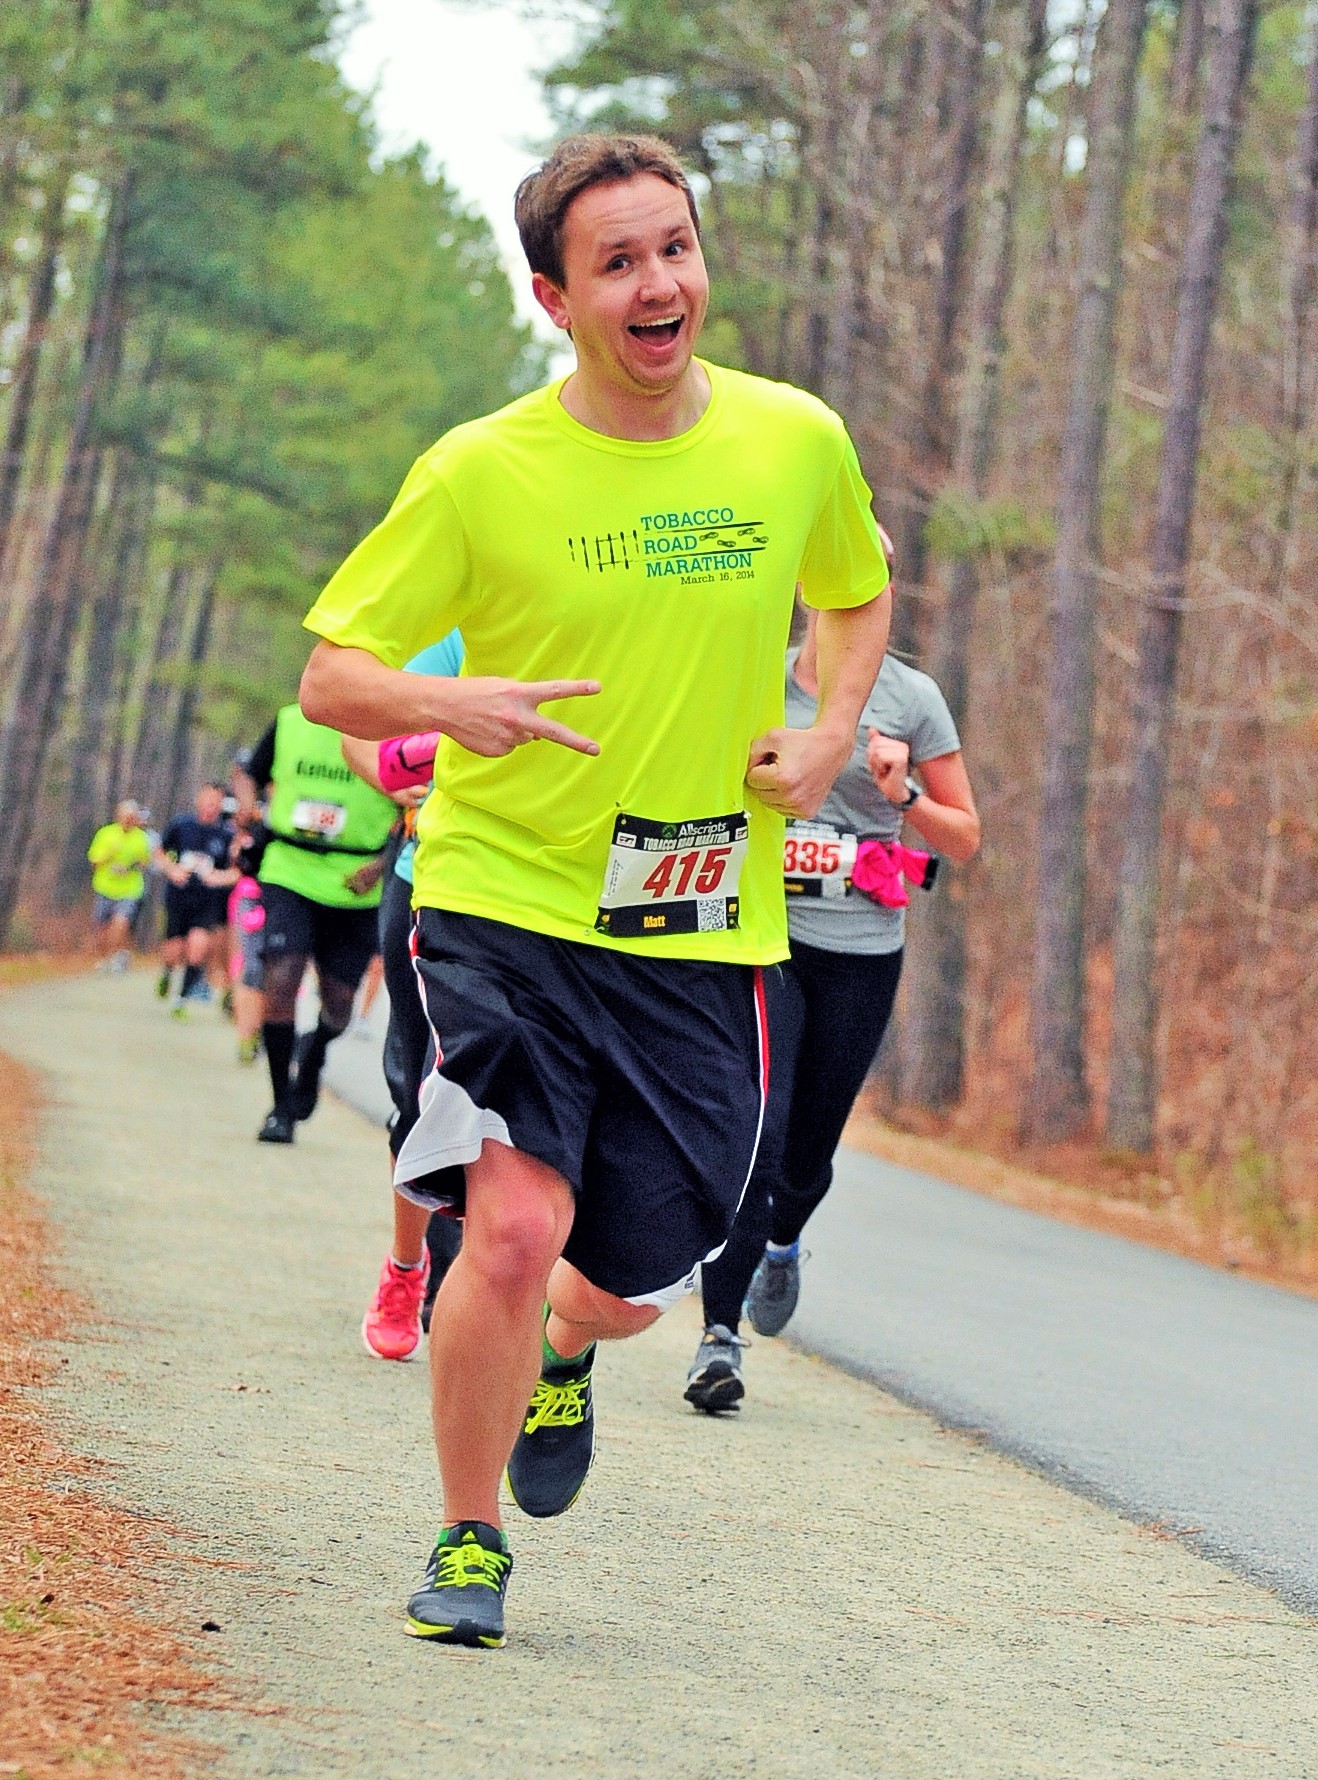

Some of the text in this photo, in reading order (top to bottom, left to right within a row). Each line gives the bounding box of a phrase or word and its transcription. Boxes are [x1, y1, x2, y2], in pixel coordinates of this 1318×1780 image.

[641, 508, 733, 531] TOBACCO
[644, 535, 697, 555] ROAD
[646, 553, 752, 577] MARATHON
[681, 570, 755, 585] March 16, 2014
[678, 821, 727, 838] Allscripts
[643, 837, 677, 851] TOBACCO
[694, 831, 730, 847] MARATHON
[642, 847, 733, 898] 415
[643, 915, 666, 928] Matt
